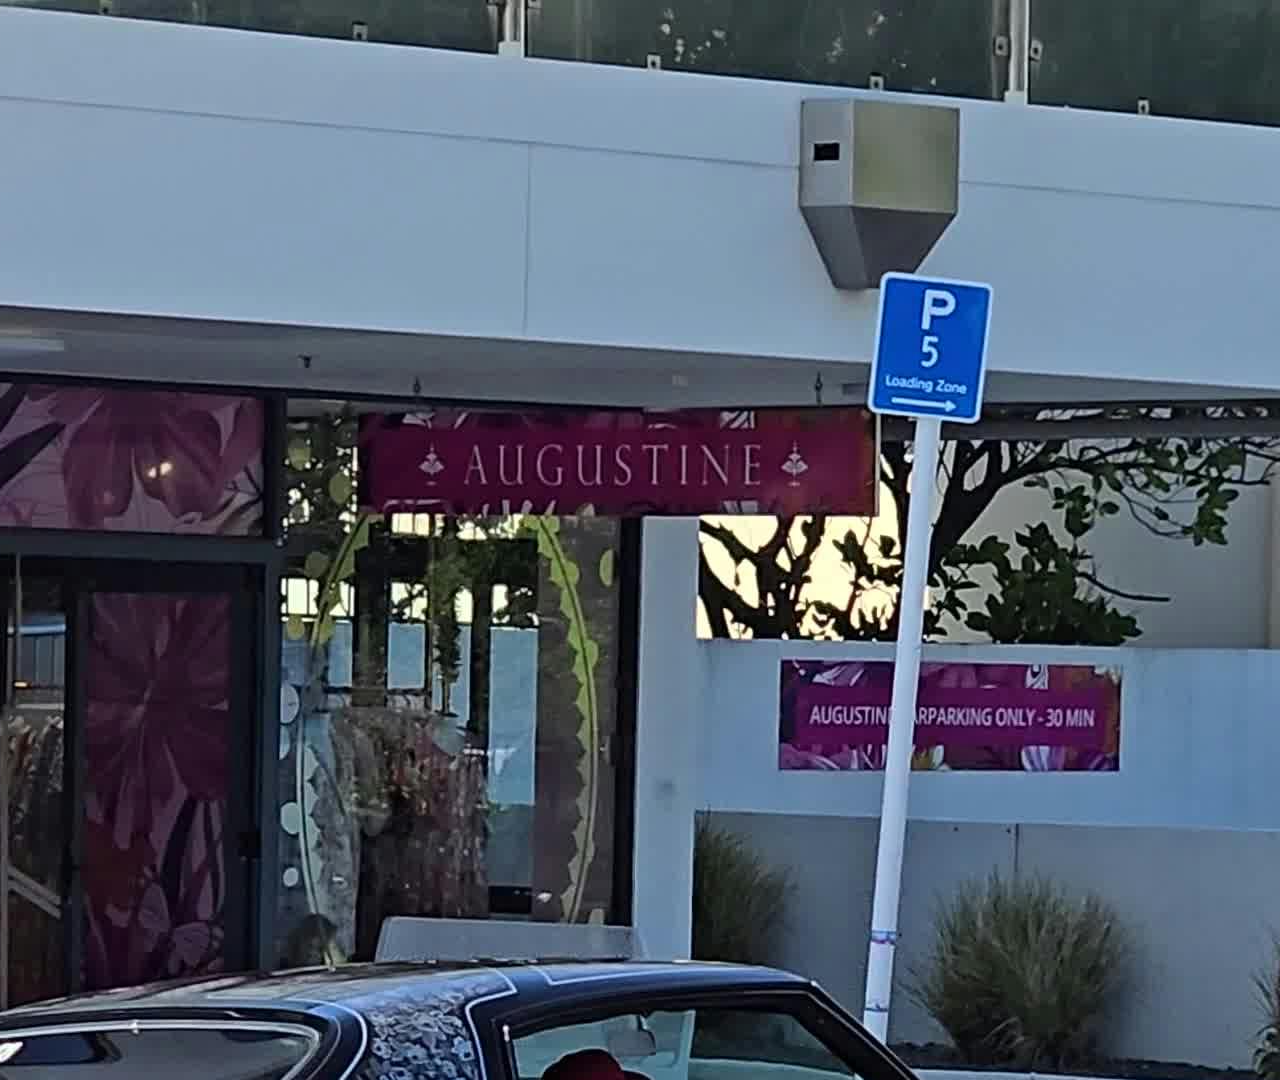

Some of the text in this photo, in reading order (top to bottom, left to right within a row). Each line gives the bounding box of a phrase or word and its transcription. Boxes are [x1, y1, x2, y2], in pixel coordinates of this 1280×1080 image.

[921, 289, 956, 330] P
[921, 336, 939, 367] 5
[885, 374, 967, 394] Loading Zone
[464, 444, 761, 486] AUGUSTINE
[915, 706, 992, 726] RPARKING
[995, 707, 1036, 727] ONLY
[1045, 708, 1063, 727] 30
[1066, 708, 1095, 727] MIN
